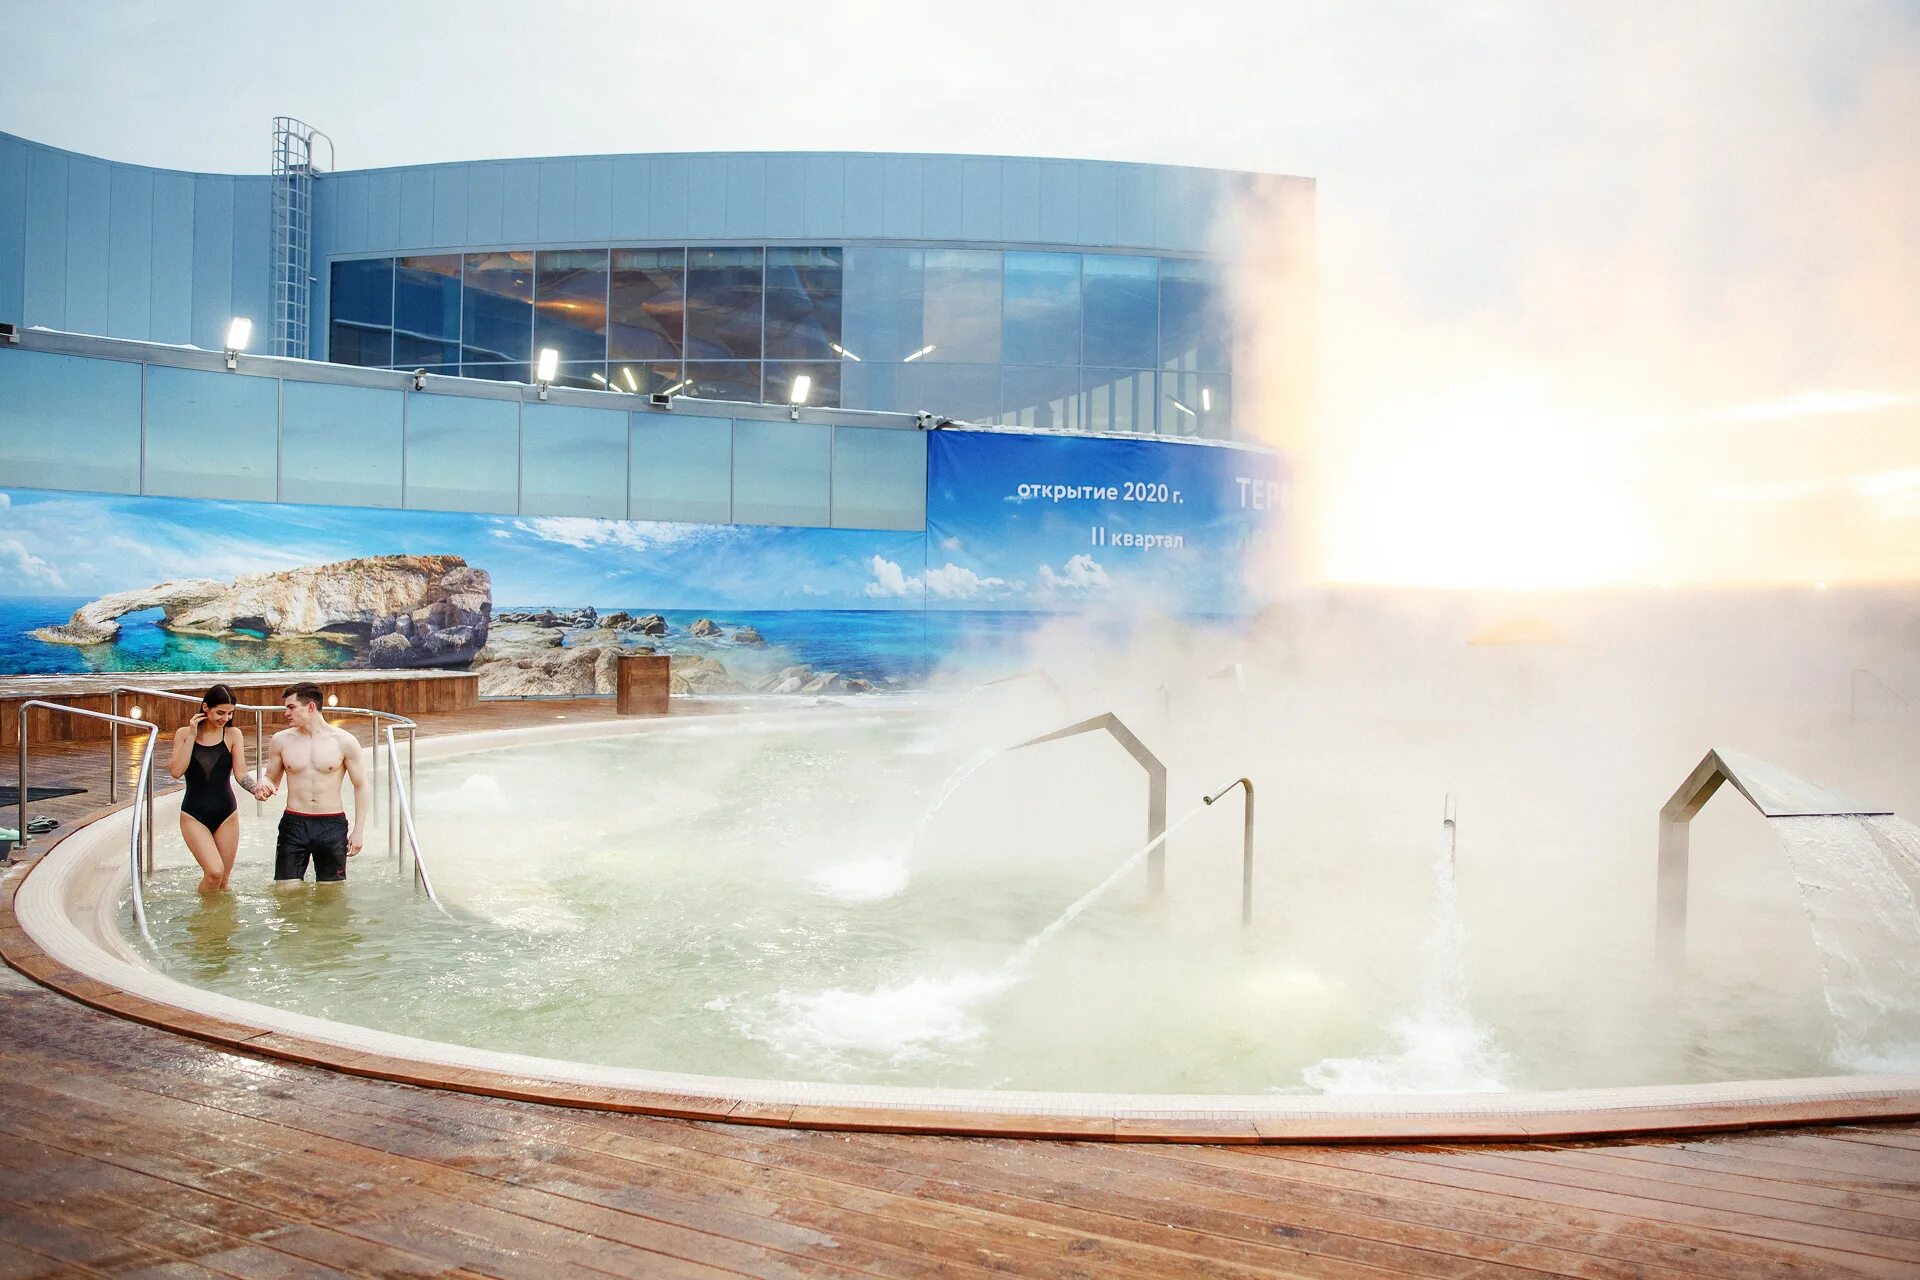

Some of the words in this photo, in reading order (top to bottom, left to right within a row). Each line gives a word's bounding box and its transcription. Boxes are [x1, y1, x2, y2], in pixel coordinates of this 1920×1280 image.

[1017, 483, 1118, 503] открытие
[1123, 481, 1168, 503] 2020
[1171, 489, 1184, 504] г.
[1111, 532, 1184, 551] квартал
